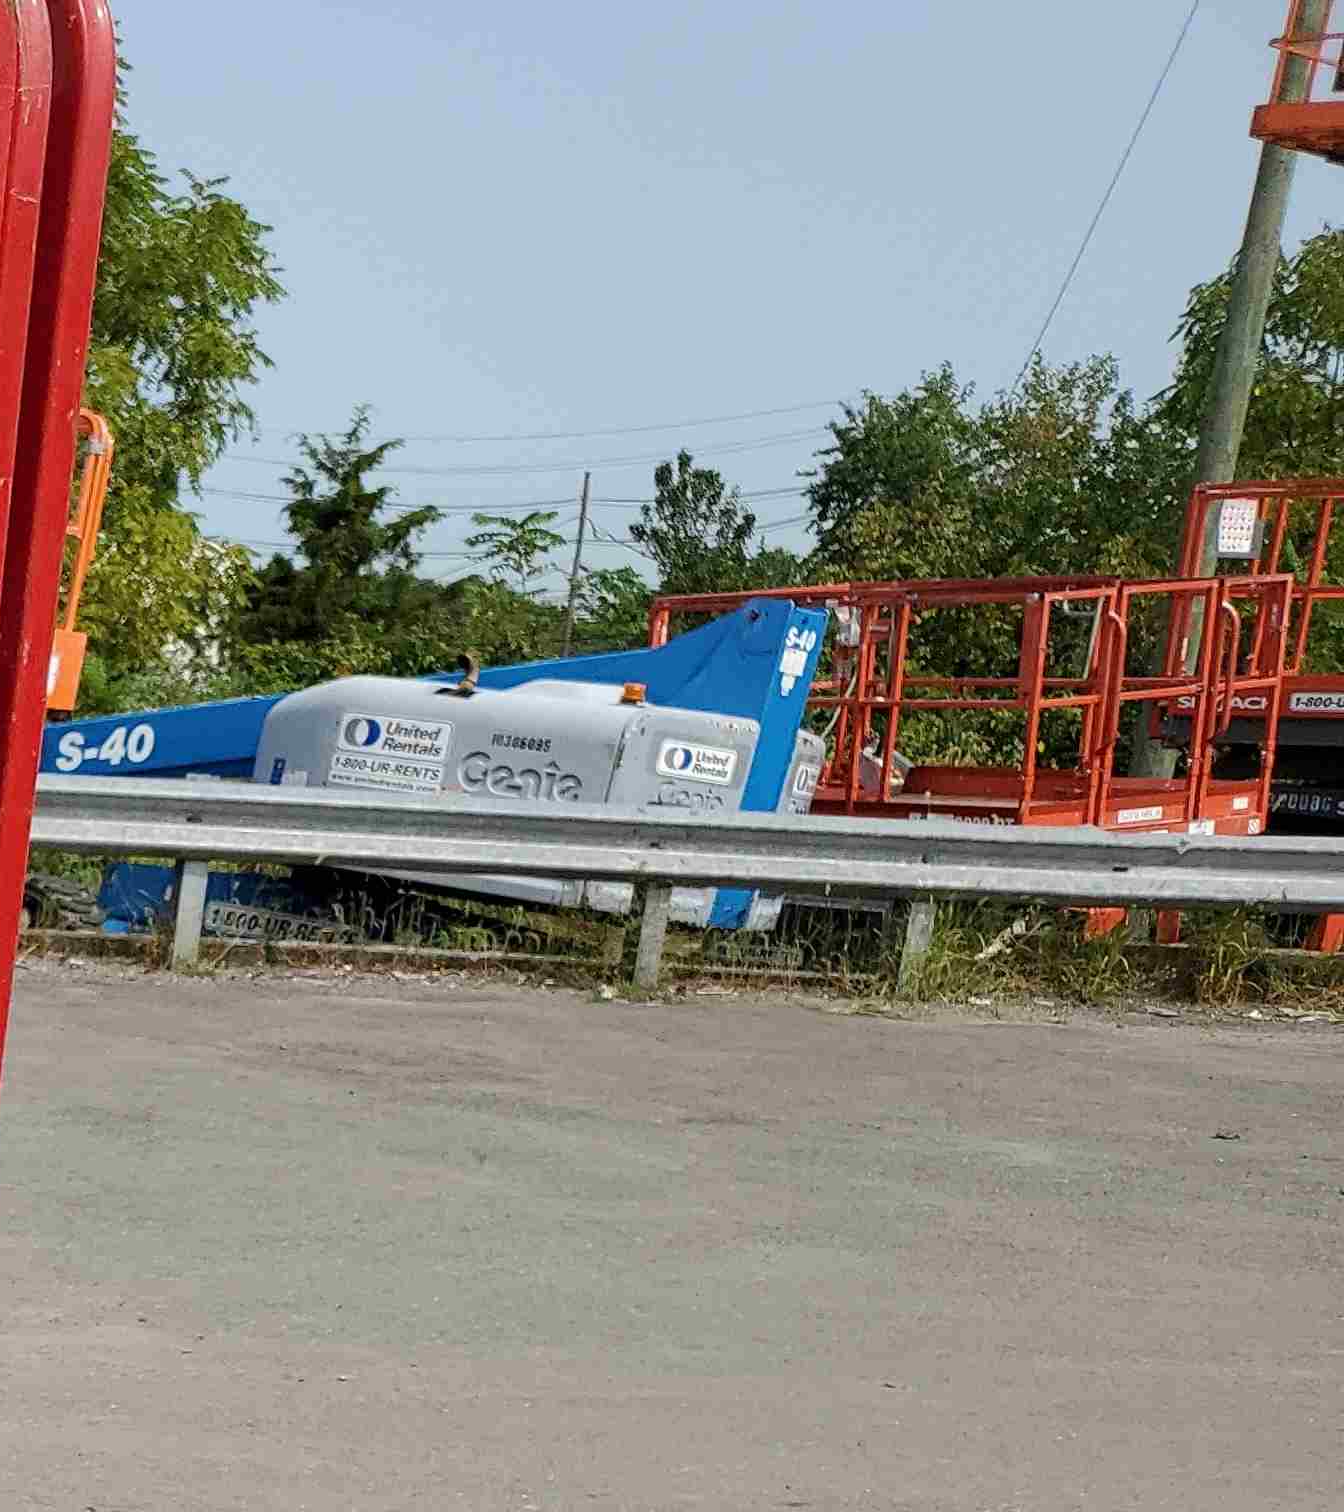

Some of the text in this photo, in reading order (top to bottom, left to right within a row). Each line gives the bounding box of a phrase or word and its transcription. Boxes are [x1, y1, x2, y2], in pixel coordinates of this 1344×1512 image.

[785, 625, 817, 652] S-40
[385, 721, 442, 742] United
[55, 723, 155, 772] S-40
[381, 736, 442, 757] Rentals
[335, 756, 441, 781] 1-800-UR-RENTS
[458, 751, 583, 801] Genie
